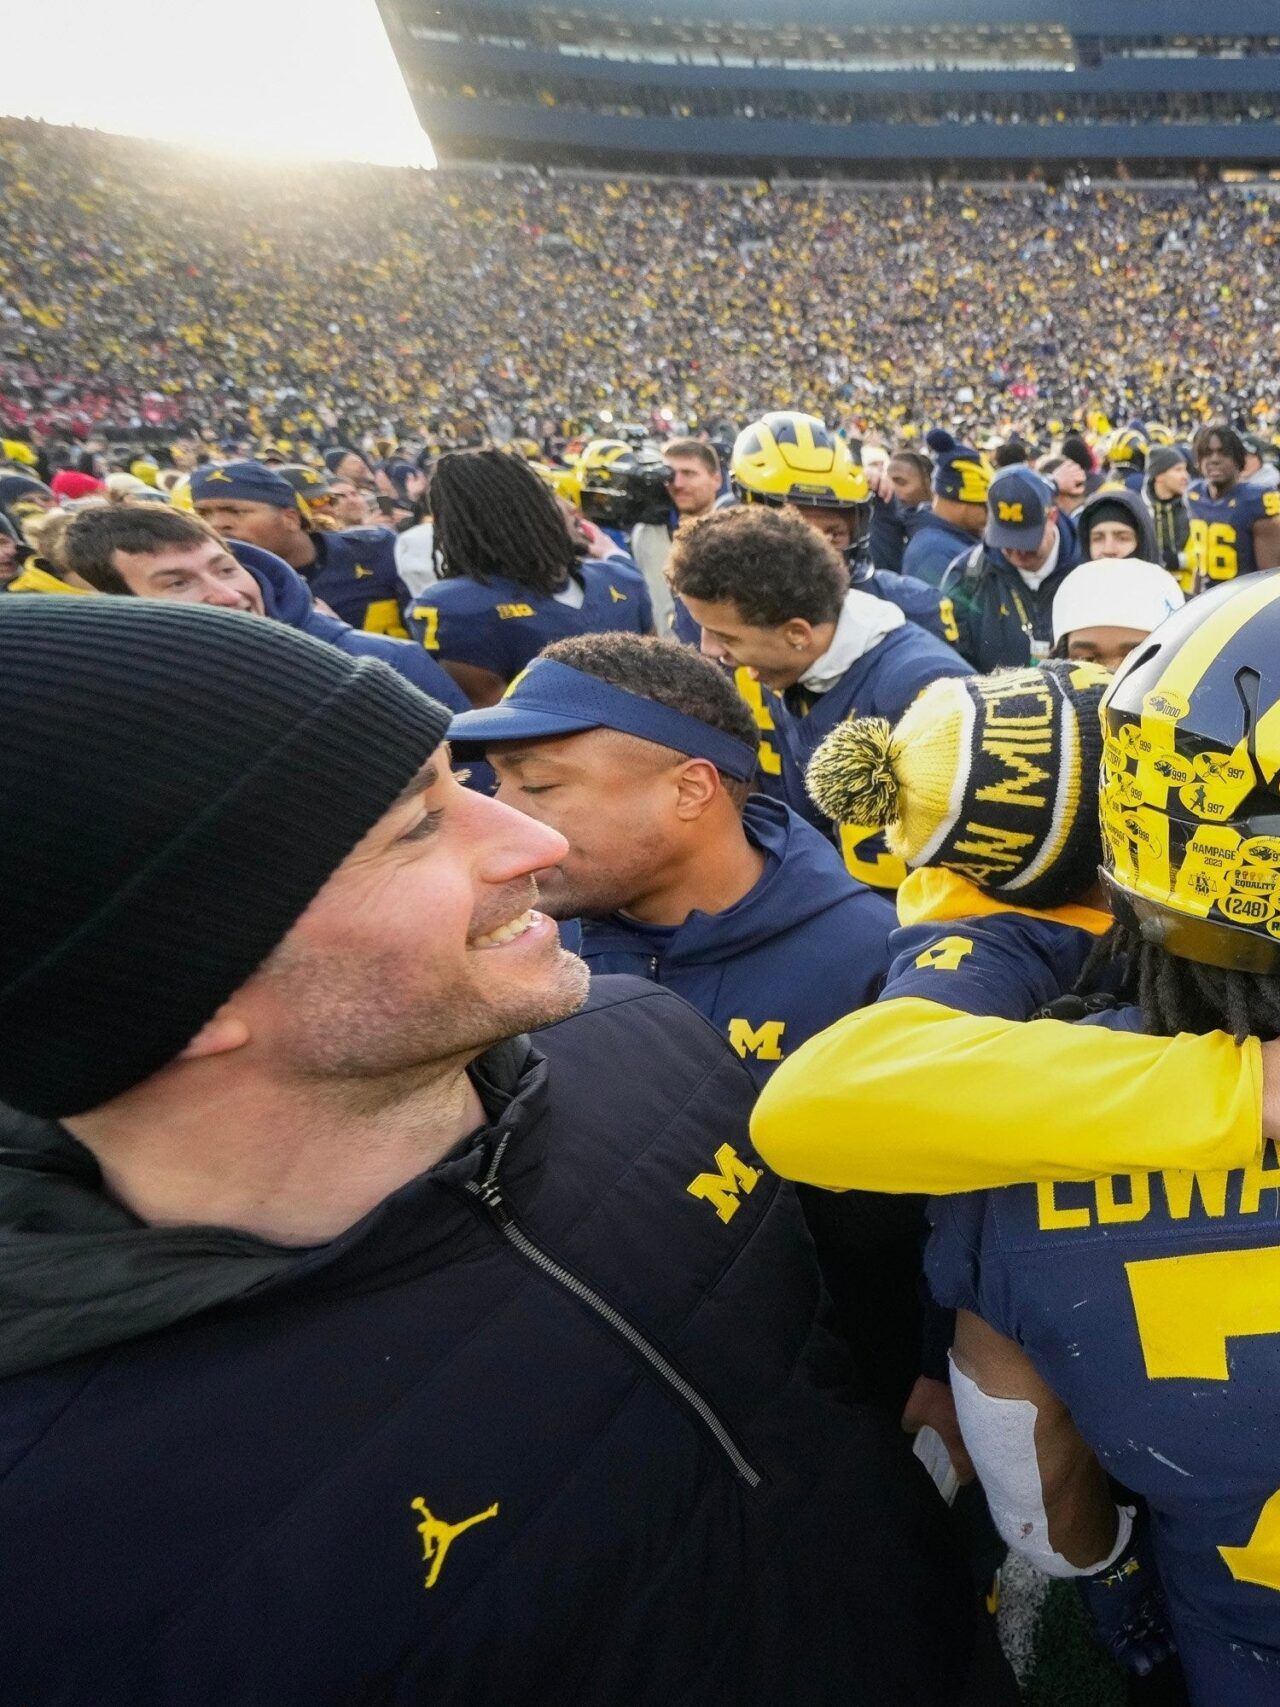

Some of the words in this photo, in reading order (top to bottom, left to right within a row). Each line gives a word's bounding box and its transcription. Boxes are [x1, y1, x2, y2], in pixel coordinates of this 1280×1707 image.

[998, 501, 1024, 523] M
[412, 606, 440, 650] 7
[1171, 770, 1187, 783] 999
[1227, 767, 1245, 780] 997
[1207, 802, 1224, 815] 997
[1192, 842, 1237, 861] RAMPAGE
[1203, 858, 1223, 868] 2023
[1234, 880, 1277, 891] EQUALITY
[1225, 896, 1269, 919] (248)
[728, 1017, 786, 1061] M
[687, 1142, 761, 1225] M
